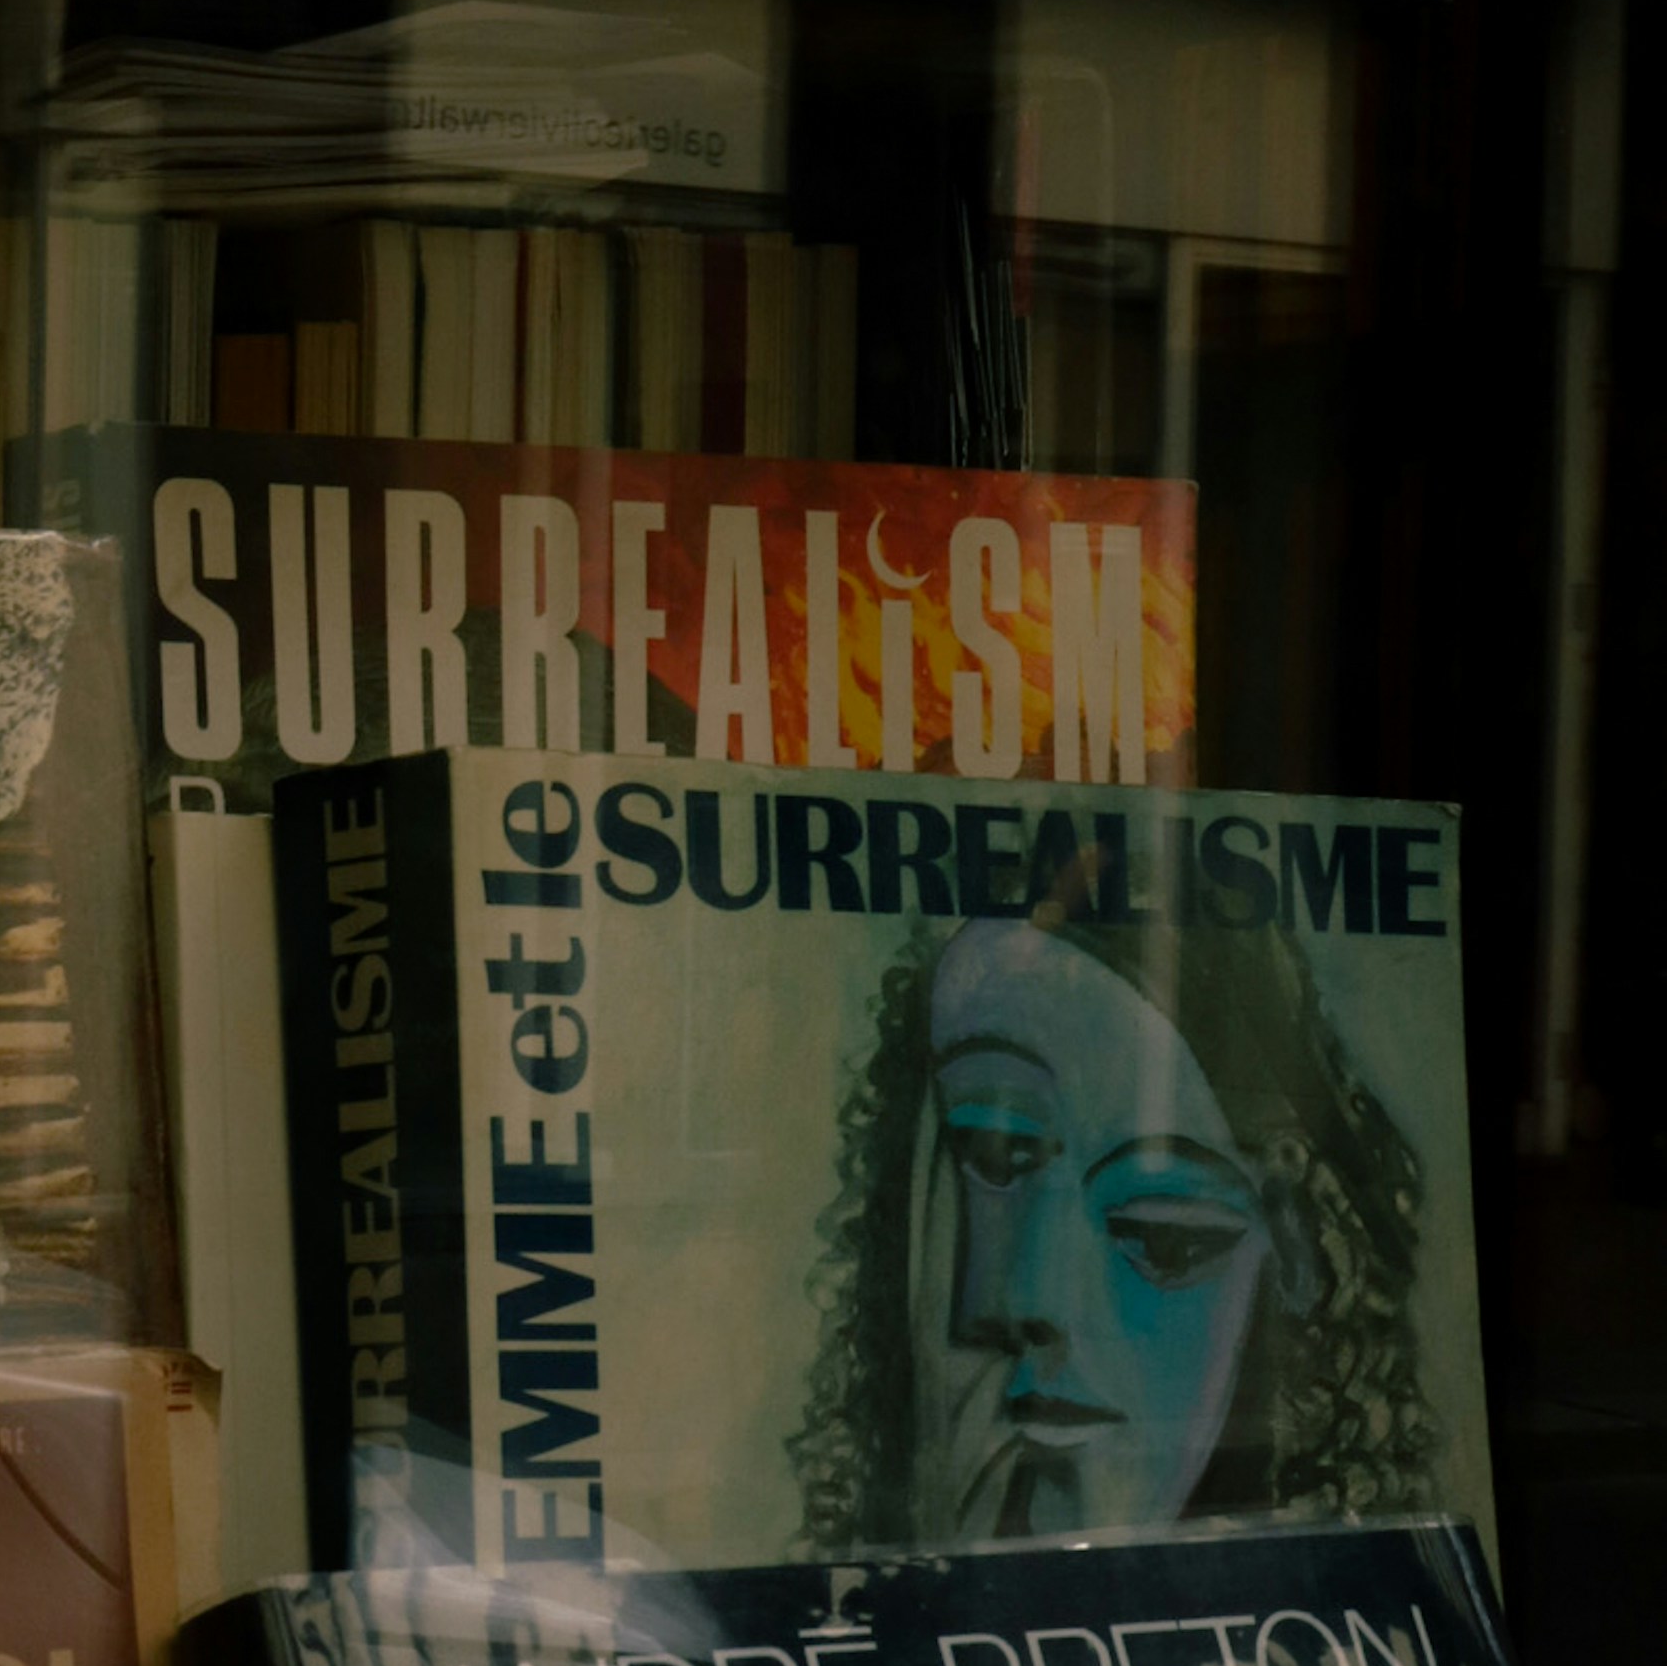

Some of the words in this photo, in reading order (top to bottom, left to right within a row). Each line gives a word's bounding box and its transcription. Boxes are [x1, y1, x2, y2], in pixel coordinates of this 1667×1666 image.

[481, 780, 582, 909] le
[595, 780, 1447, 936] SURREALISME
[484, 932, 591, 1095] et
